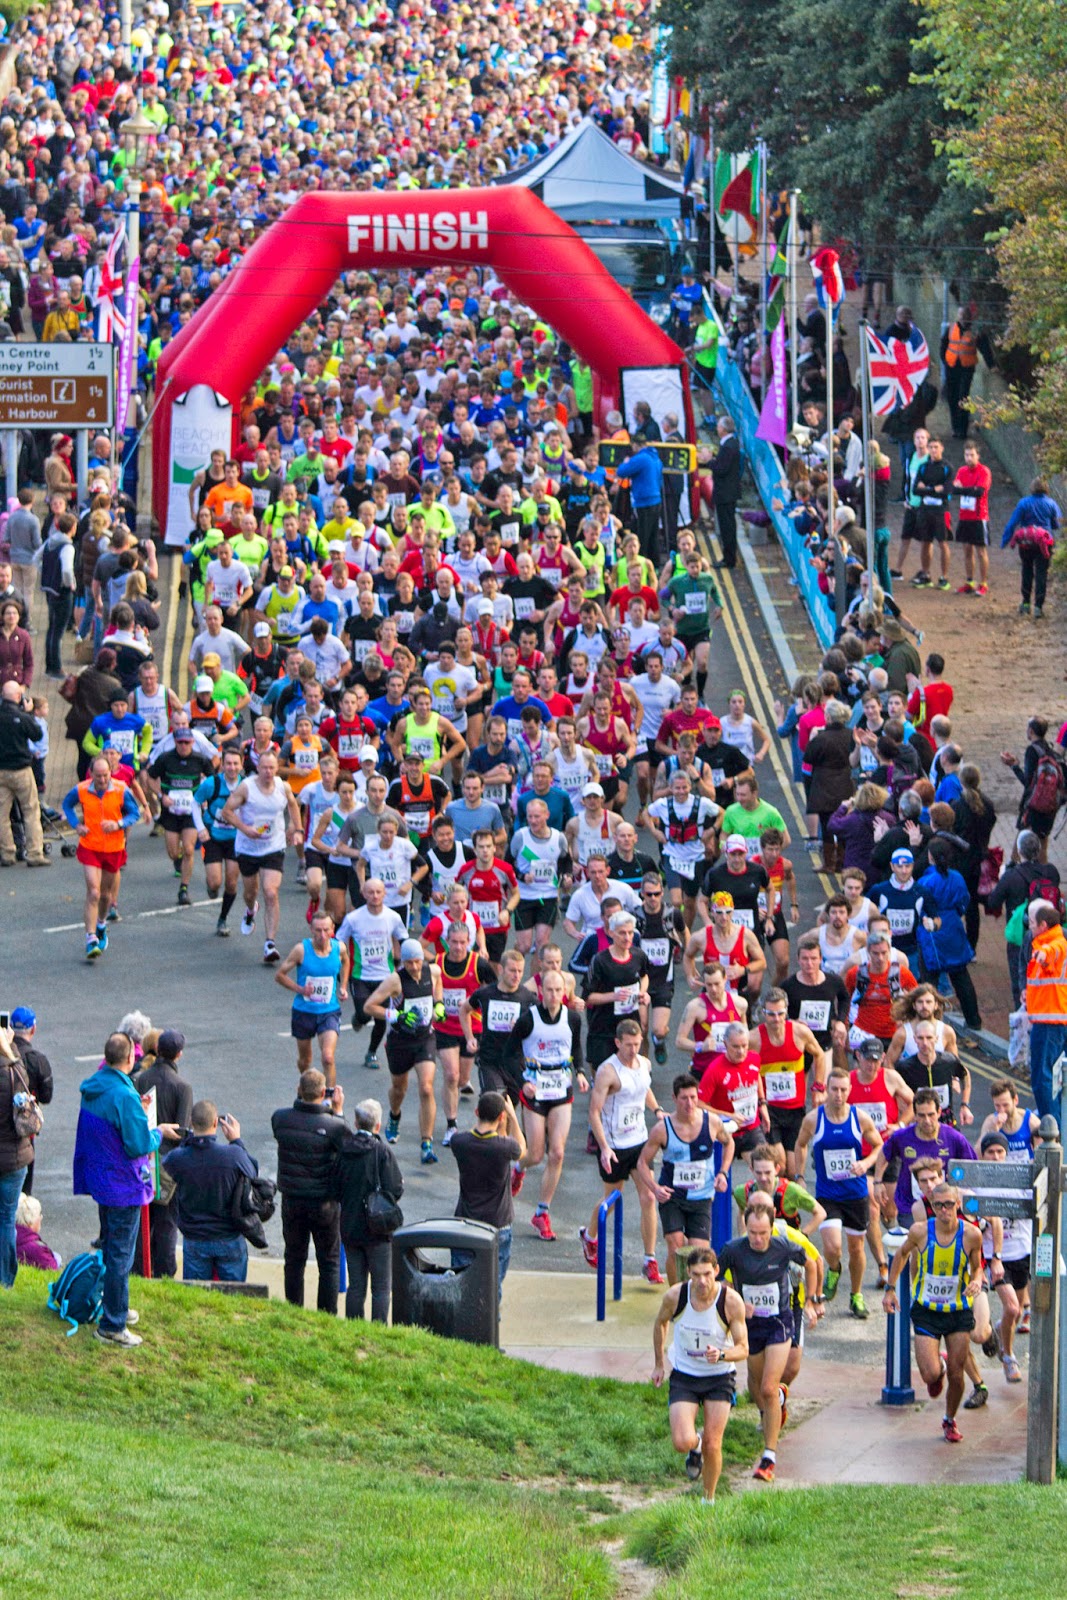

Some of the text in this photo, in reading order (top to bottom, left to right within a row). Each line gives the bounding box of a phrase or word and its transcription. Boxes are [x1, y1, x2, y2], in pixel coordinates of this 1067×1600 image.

[347, 211, 488, 252] FINISH
[10, 348, 50, 358] Centre
[0, 361, 95, 373] ney Point 4
[0, 379, 33, 390] ourist
[0, 391, 47, 402] rmation
[8, 407, 58, 419] Harbour
[86, 408, 96, 419] 4
[174, 427, 227, 440] BEACHY
[174, 443, 210, 455] HEAD
[491, 1011, 515, 1022] 2047
[830, 1159, 851, 1172] 932
[926, 1283, 954, 1294] 2067
[749, 1295, 775, 1306] 1296
[694, 1336, 700, 1349] 1
